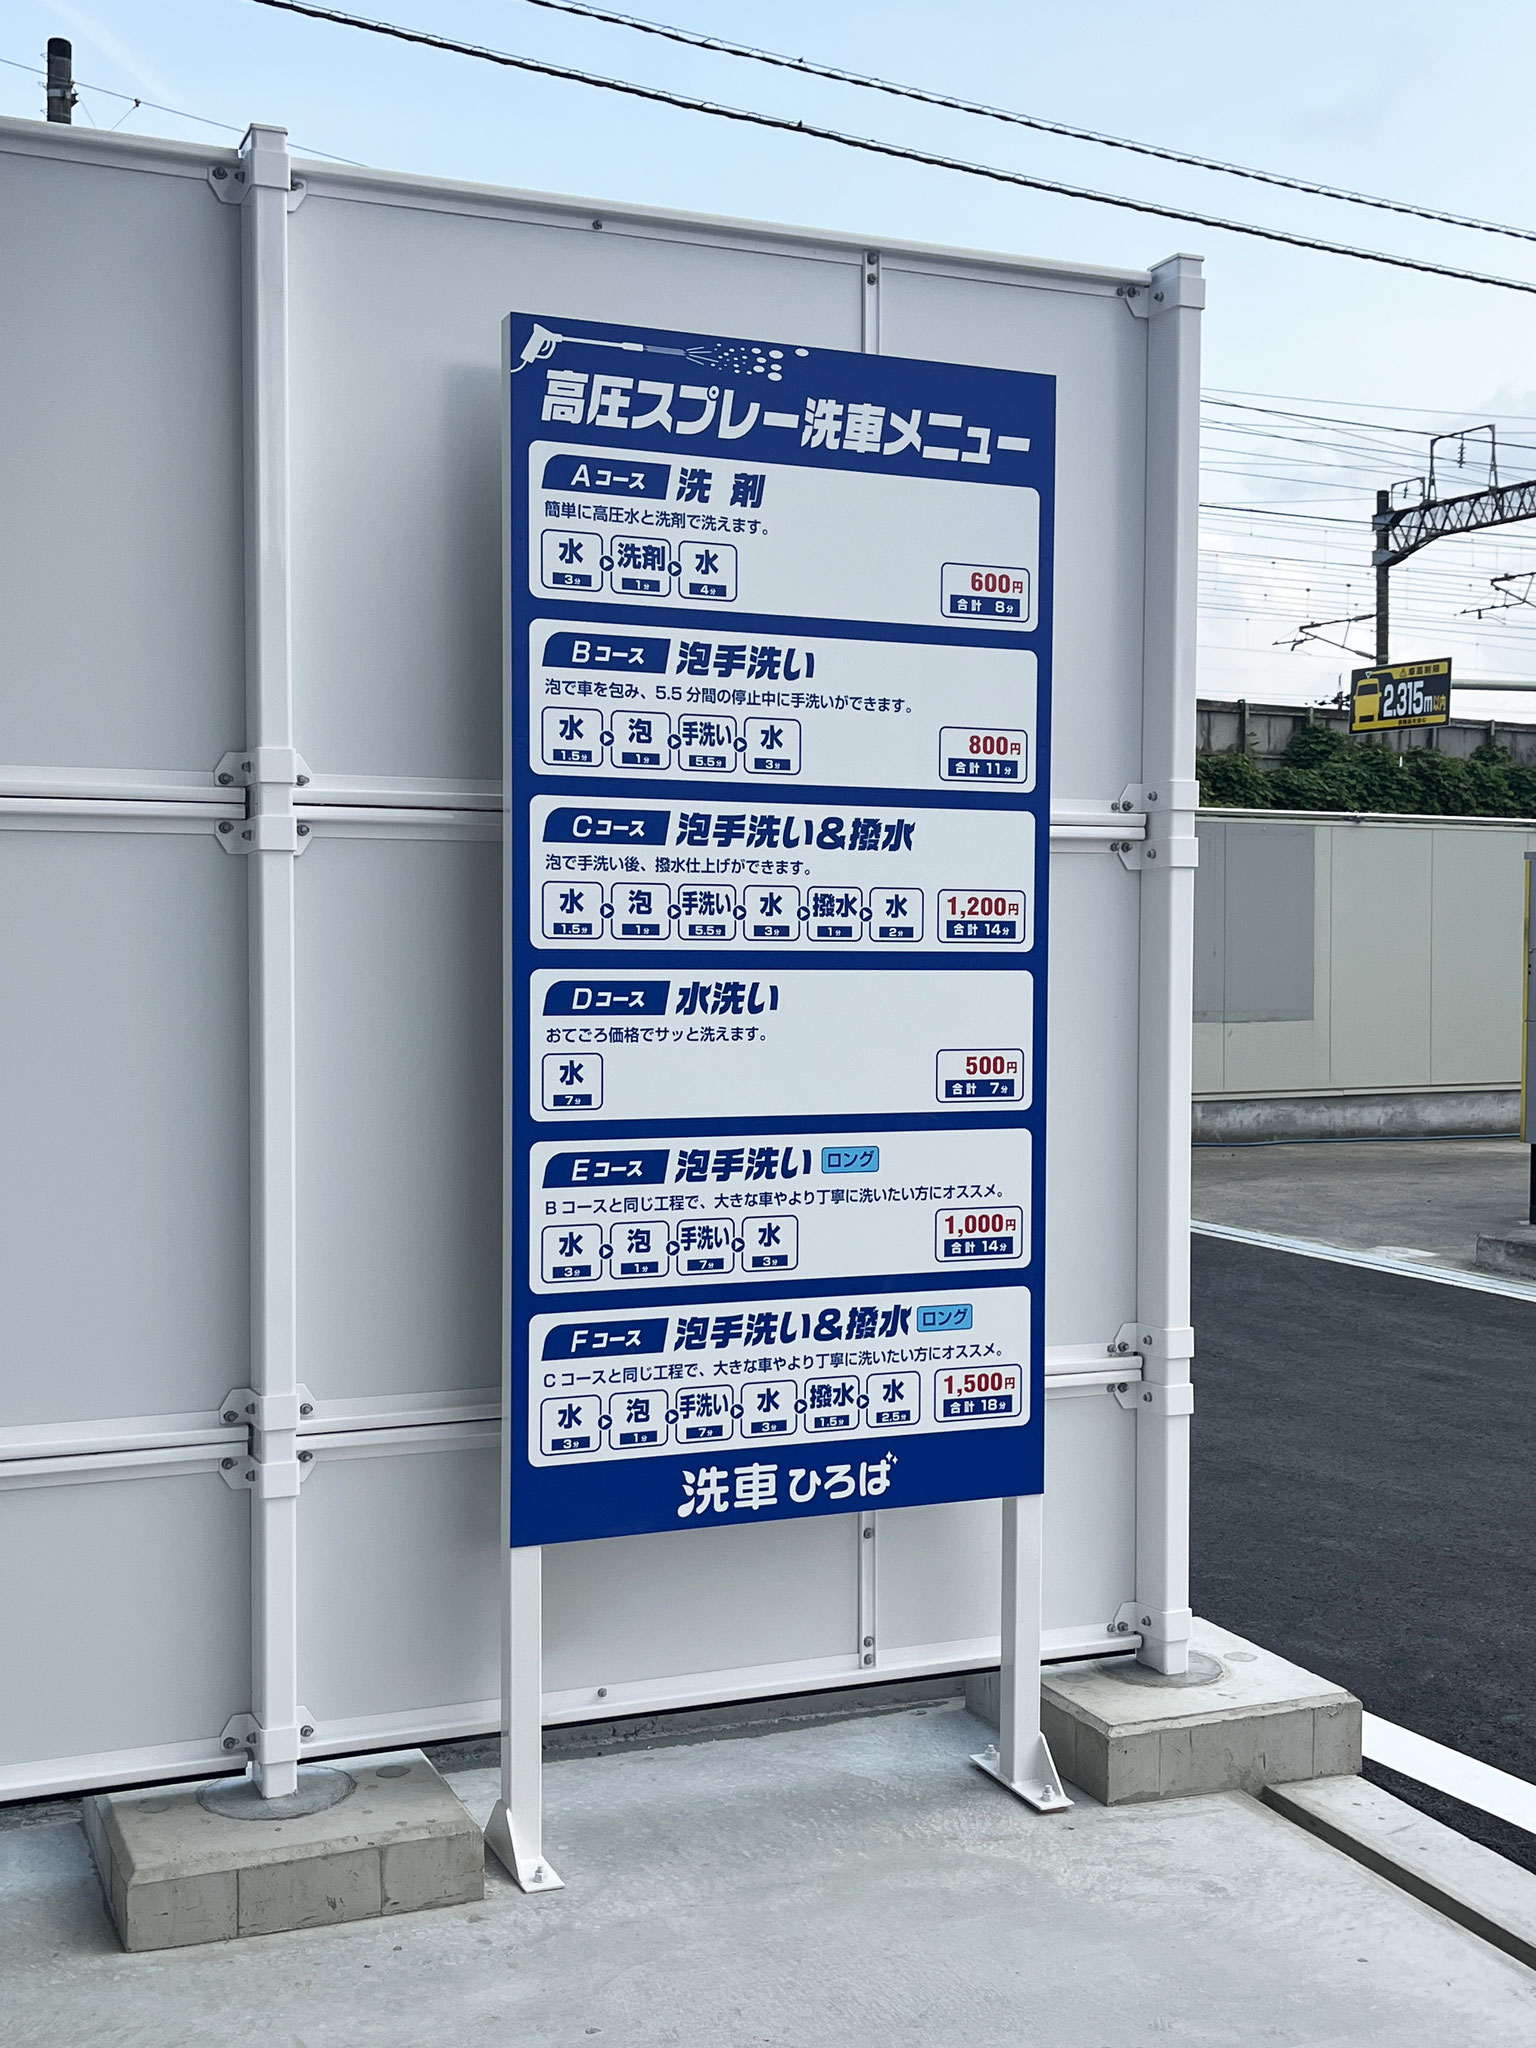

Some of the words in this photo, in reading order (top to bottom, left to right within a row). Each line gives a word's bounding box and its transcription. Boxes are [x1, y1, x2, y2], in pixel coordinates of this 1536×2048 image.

[540, 369, 1032, 465] 高圧スプレー洗車メニュー
[571, 464, 646, 490] Aコース
[545, 500, 768, 536] 簡単に高圧水と洗剤で洗えます。
[558, 538, 583, 564] 水
[618, 543, 665, 571] 洗剤
[695, 549, 719, 575] 水
[564, 575, 581, 585] 3分
[635, 581, 650, 590] 1分
[700, 585, 716, 595] 4分
[971, 572, 1023, 594] 600円
[571, 640, 645, 665] Bコース
[676, 641, 814, 682] 泡手洗い
[559, 715, 583, 741] 水
[628, 718, 652, 743] 泡
[682, 721, 732, 747] 手洗い
[760, 725, 783, 749] 水
[969, 735, 1021, 756] 800円
[560, 751, 588, 761] 1.5分
[635, 754, 650, 764] 1分
[695, 757, 722, 767] 5.5分
[765, 759, 781, 769] 3分
[572, 815, 646, 837] Cコース
[675, 812, 916, 852] 泡手洗い&撥水
[545, 853, 810, 876] 泡で手洗い後、撥水仕上げができます。
[559, 888, 584, 914] 水
[628, 890, 652, 915] 泡
[681, 891, 731, 916] 手洗い
[760, 892, 783, 917] 水
[812, 893, 857, 918] 撥水
[886, 894, 907, 918] 水
[947, 896, 1019, 919] 1,200円
[560, 924, 588, 934] 1.5分
[635, 925, 650, 934] 1分
[695, 926, 722, 935] 5.5分
[764, 926, 780, 936] 3分
[827, 927, 841, 937] 1分
[889, 928, 904, 937] 2分
[572, 988, 645, 1010] Dコース
[675, 981, 779, 1016] 水洗い
[546, 1026, 767, 1043] おてごろ価格でサッと洗えます。
[559, 1060, 584, 1086] 水
[966, 1056, 1018, 1075] 500円
[564, 1095, 581, 1105] 7分
[571, 1158, 643, 1182] Eコース
[674, 1146, 812, 1183] 泡手洗い
[827, 1150, 875, 1168] ロング
[545, 1184, 1003, 1215] Bコースと同じ工程で、大きな車やより丁寧に洗いたい方にオススメ。
[945, 1213, 1016, 1237] 1,000円
[559, 1232, 583, 1257] 水
[627, 1228, 651, 1253] 泡
[681, 1225, 730, 1251] 手洗い
[758, 1222, 781, 1247] 水
[564, 1267, 580, 1277] 3分
[634, 1263, 649, 1273] 1分
[699, 1260, 714, 1270] 7分
[762, 1256, 778, 1267] 3分
[571, 1329, 642, 1353] Fコース
[674, 1304, 913, 1352] 泡手洗い&撥水
[922, 1308, 968, 1326] ロング
[543, 1343, 1002, 1388] Cコースと同じ工程で、大きな車やより丁寧に洗いたい方にオススメ。
[944, 1372, 1015, 1397] 1,500円
[557, 1403, 583, 1430] 水
[626, 1398, 650, 1423] 泡
[680, 1393, 729, 1420] 手洗い
[757, 1388, 780, 1413] 水
[810, 1382, 854, 1409] 撥水
[883, 1378, 904, 1403] 水
[563, 1439, 580, 1449] 3分
[633, 1433, 647, 1444] 1分
[698, 1427, 713, 1437] 7分
[761, 1422, 777, 1432] 3分
[819, 1416, 844, 1427] 1.5分
[882, 1412, 907, 1422] 2.5分
